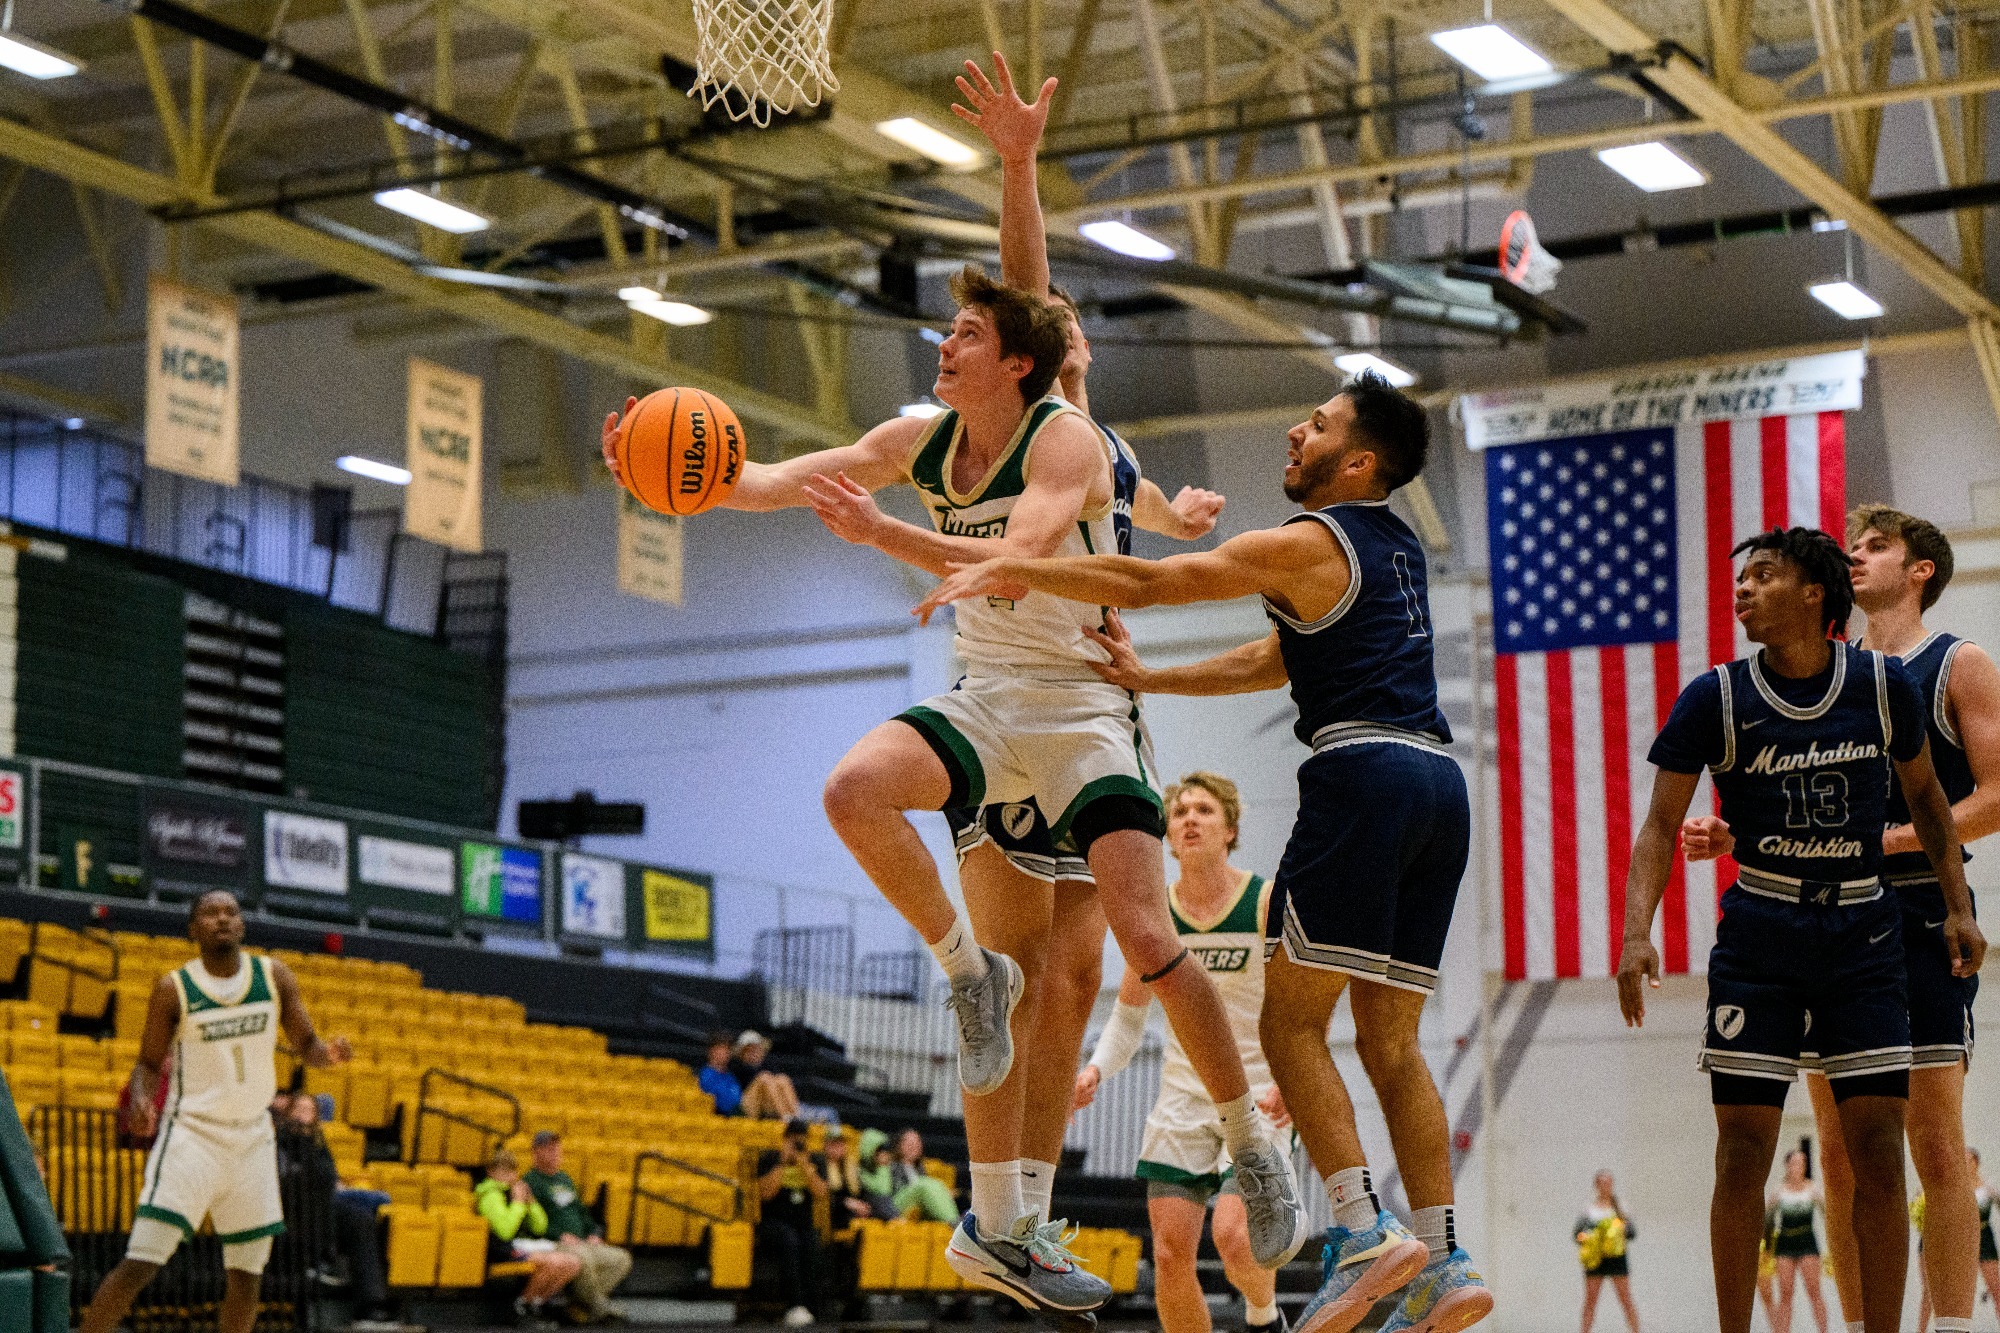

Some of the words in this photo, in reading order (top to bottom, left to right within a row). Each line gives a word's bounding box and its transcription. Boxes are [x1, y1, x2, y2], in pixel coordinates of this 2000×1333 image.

[1547, 403, 1605, 431] HOME
[1611, 399, 1638, 424] OF
[1645, 393, 1685, 421] THE
[1692, 384, 1777, 417] MINERS
[680, 411, 706, 494] Wilson
[722, 424, 739, 485] NCAA
[1393, 552, 1427, 637] 1
[1745, 741, 1878, 775] Manhattan
[1782, 771, 1849, 828] 13
[1758, 835, 1863, 859] Christian
